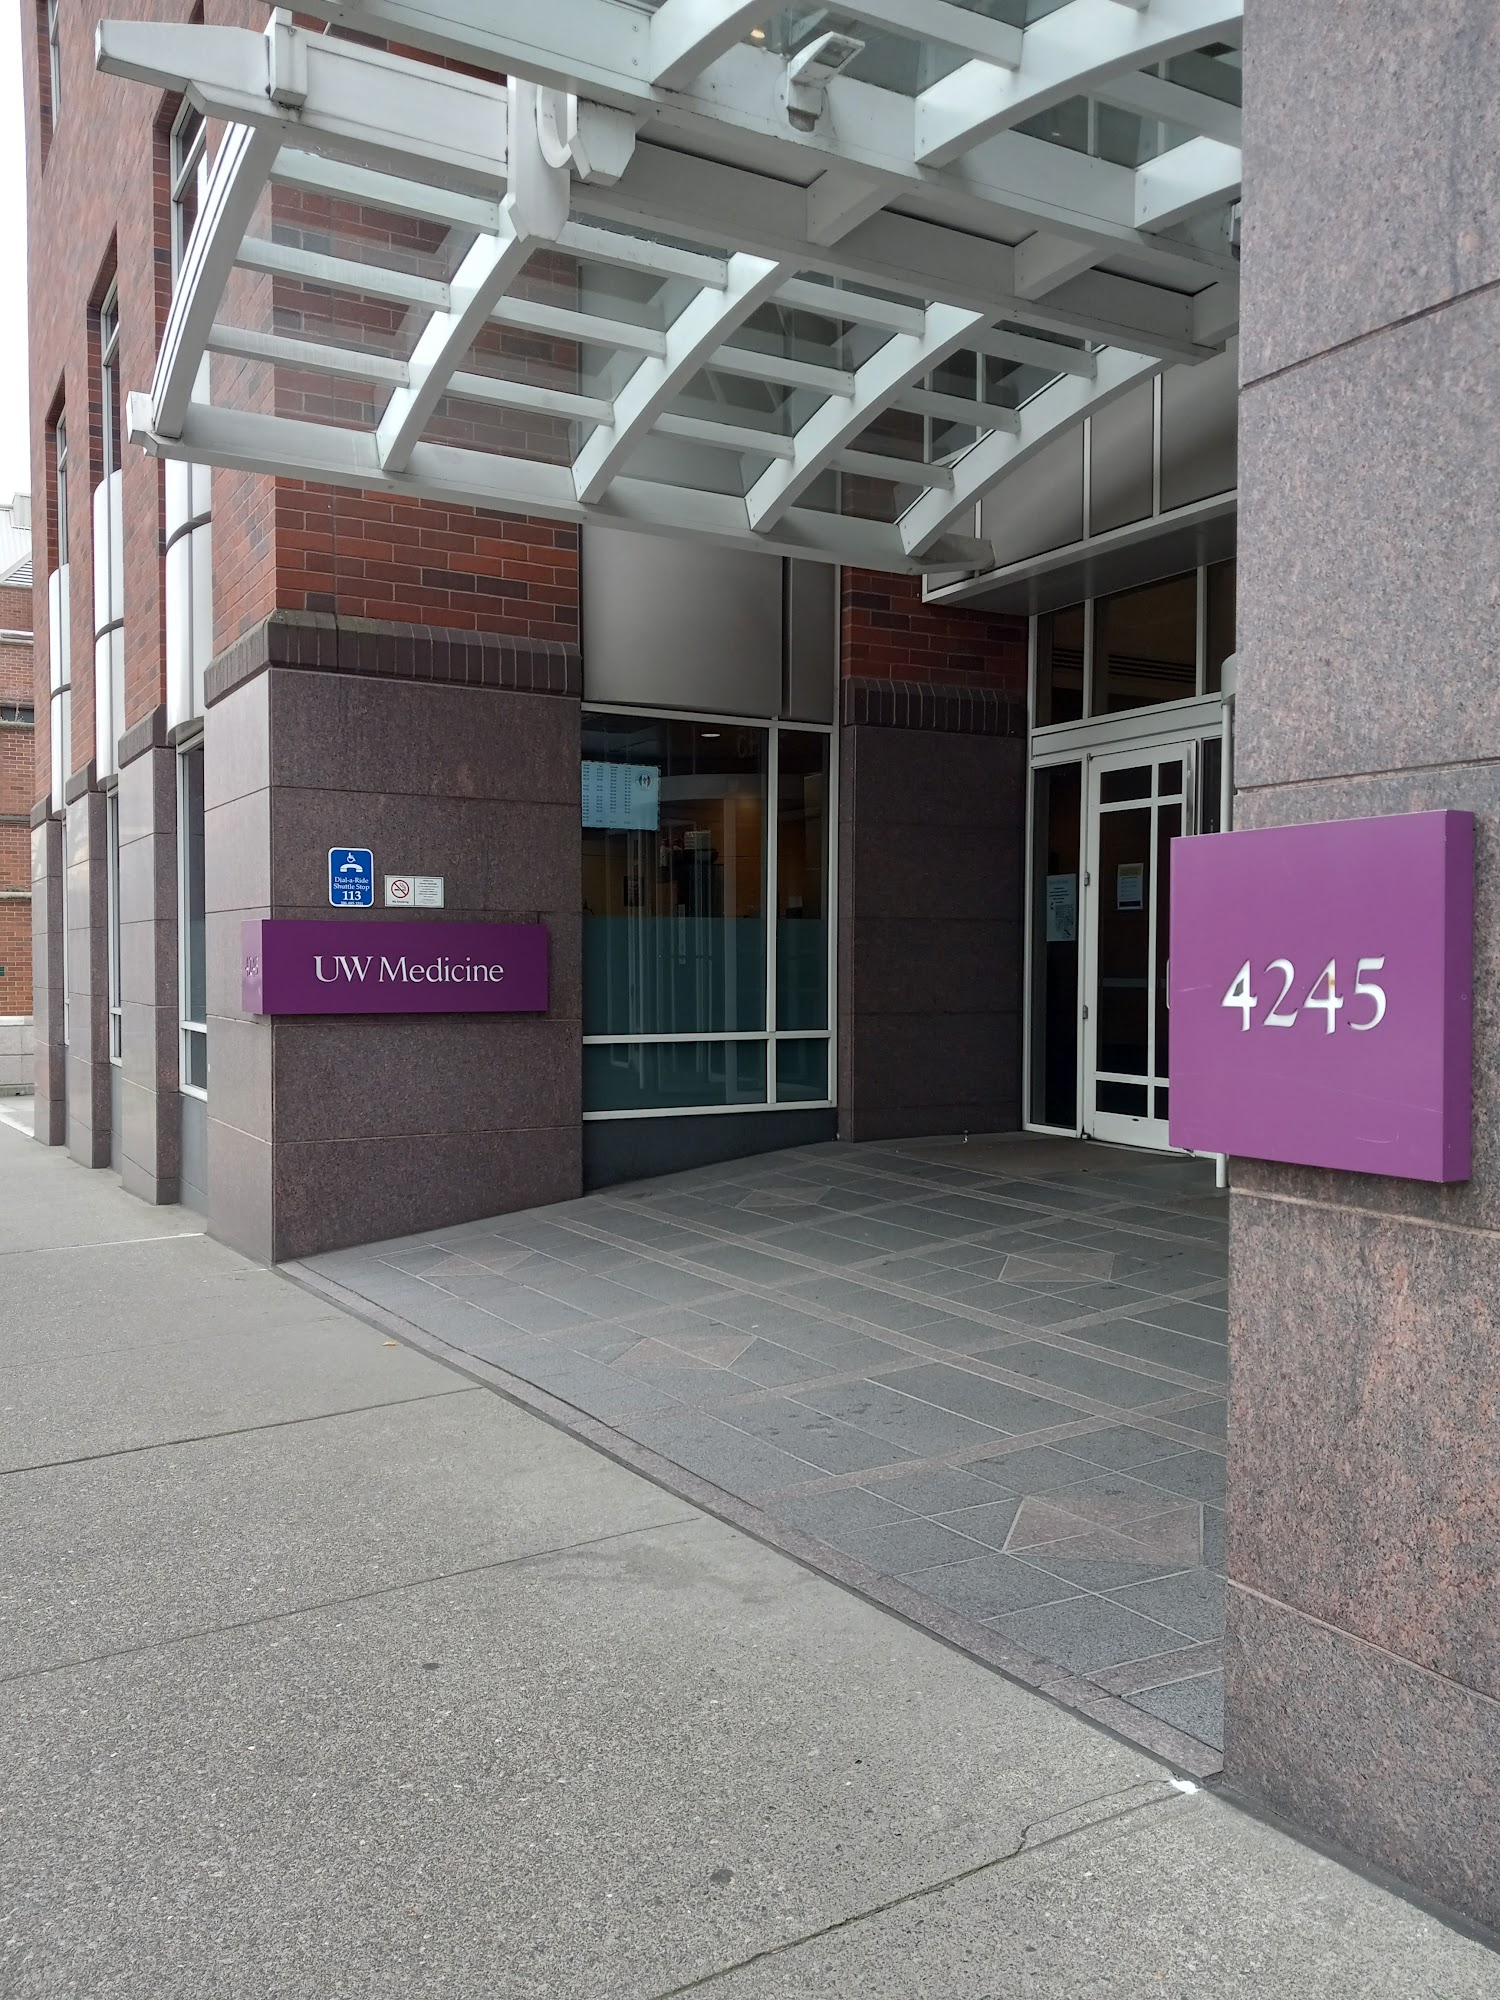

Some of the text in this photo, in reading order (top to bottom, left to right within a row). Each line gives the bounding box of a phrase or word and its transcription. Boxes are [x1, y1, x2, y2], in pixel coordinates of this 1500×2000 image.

[334, 876, 369, 884] Dial-a-Ride
[355, 884, 370, 892] Stop
[342, 890, 362, 901] 113
[313, 955, 504, 983] UW Medicine
[1220, 954, 1387, 1035] 4245
